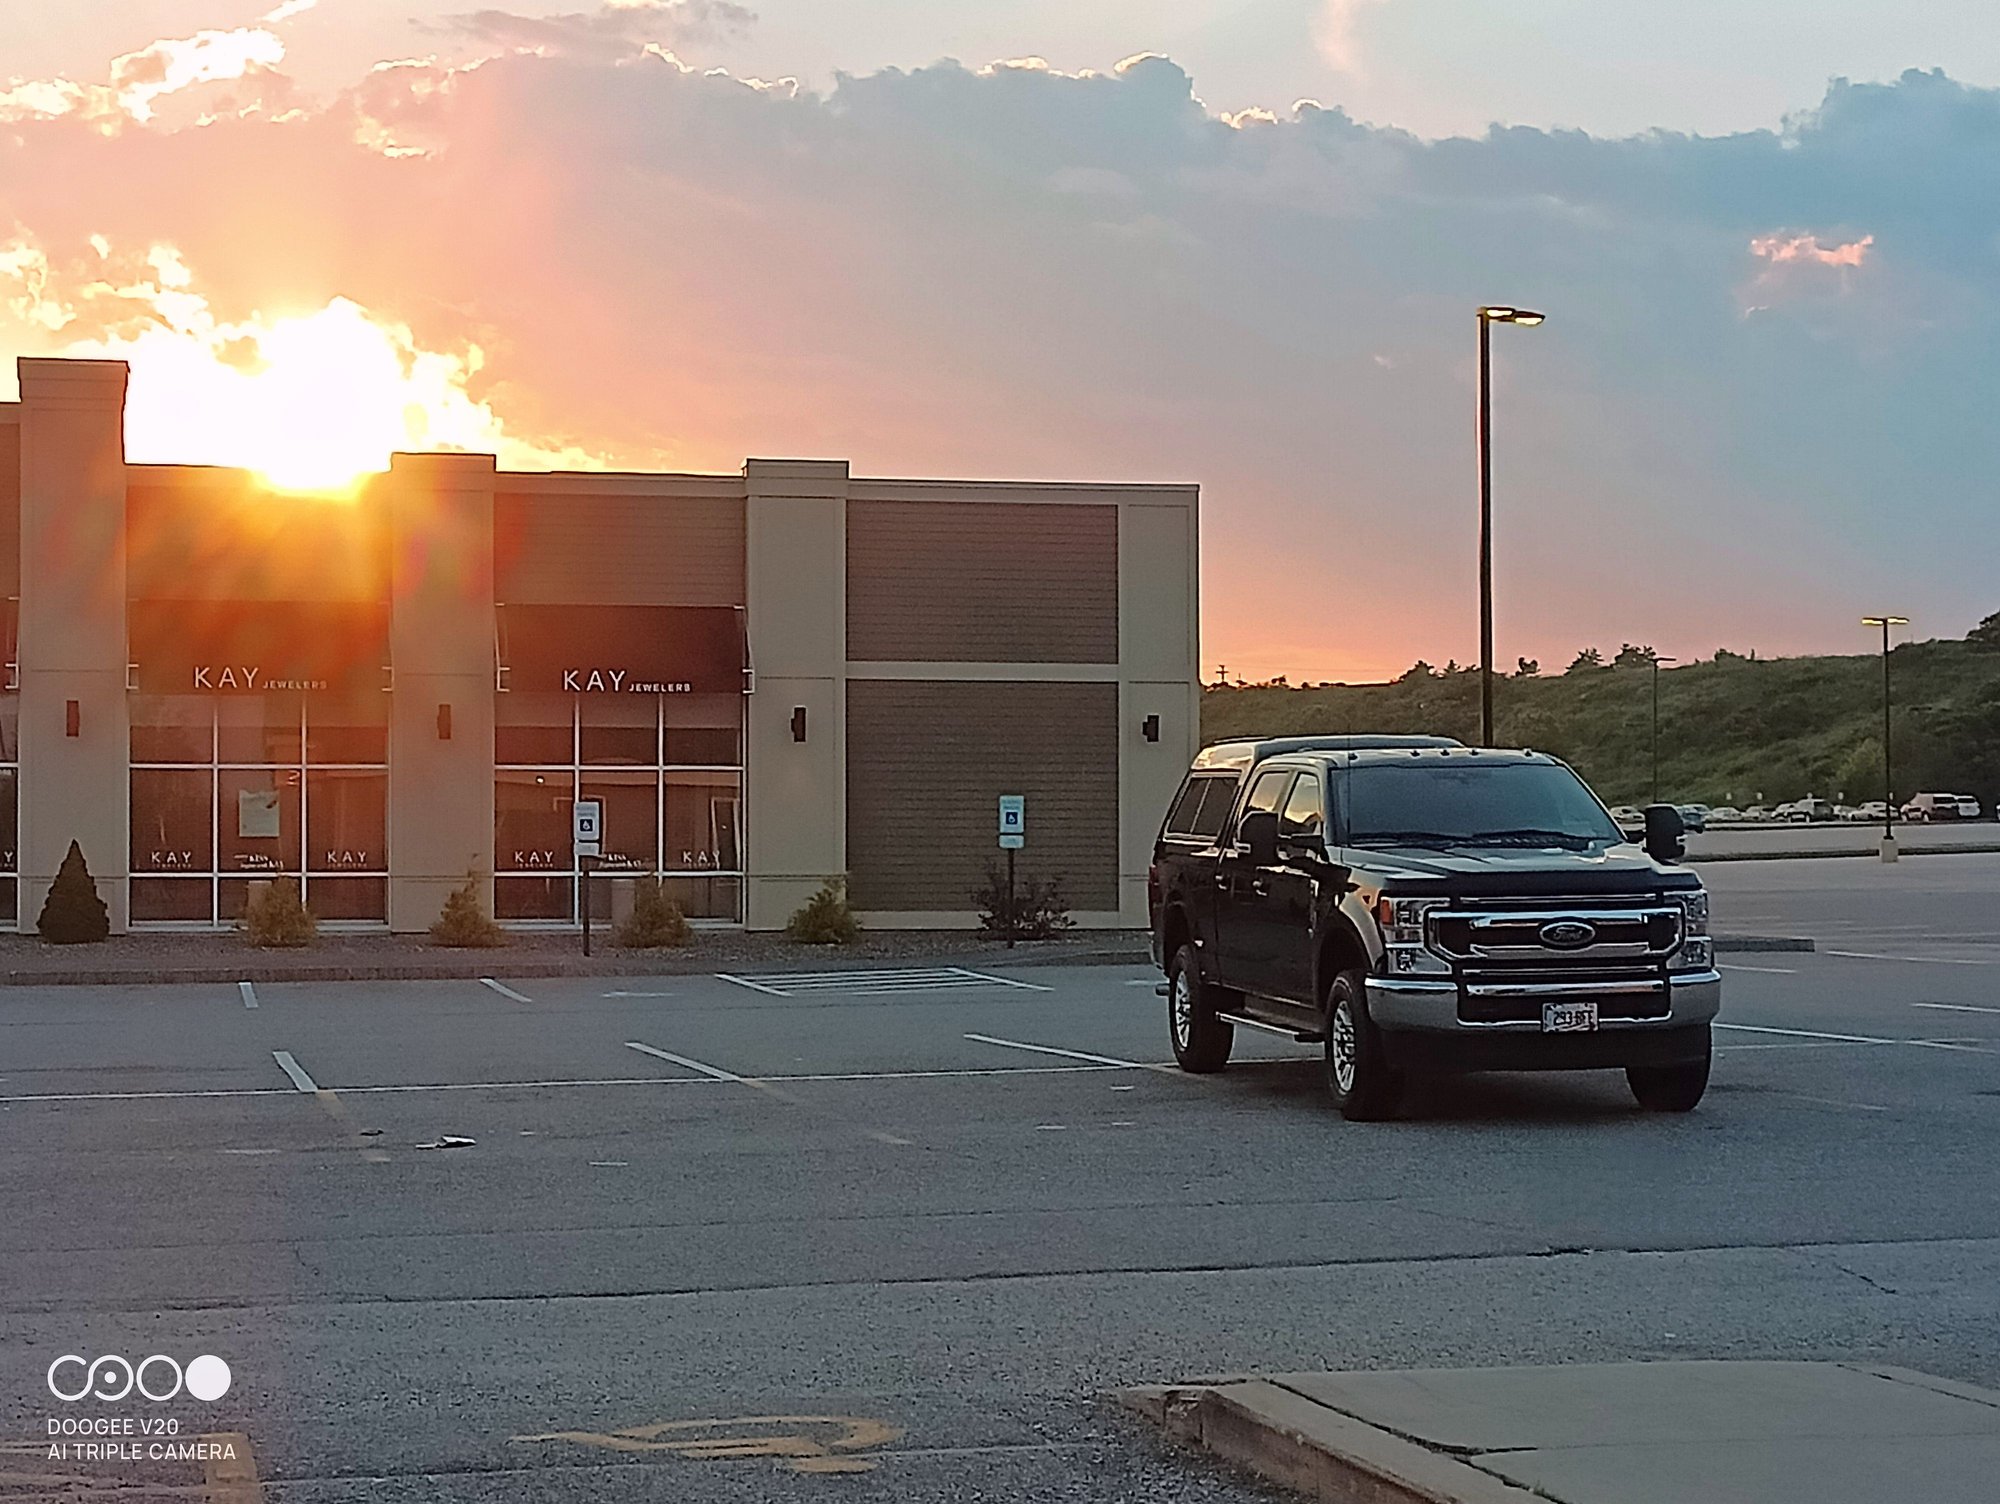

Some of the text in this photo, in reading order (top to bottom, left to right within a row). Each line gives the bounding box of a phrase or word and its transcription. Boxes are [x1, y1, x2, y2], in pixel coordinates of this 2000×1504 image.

[193, 666, 328, 690] KAY JEWELERS
[562, 669, 692, 693] KAY JEWELERS
[151, 850, 192, 863] KAY
[327, 850, 367, 863] KAY
[514, 850, 554, 863] KAY
[682, 850, 721, 863] KAY
